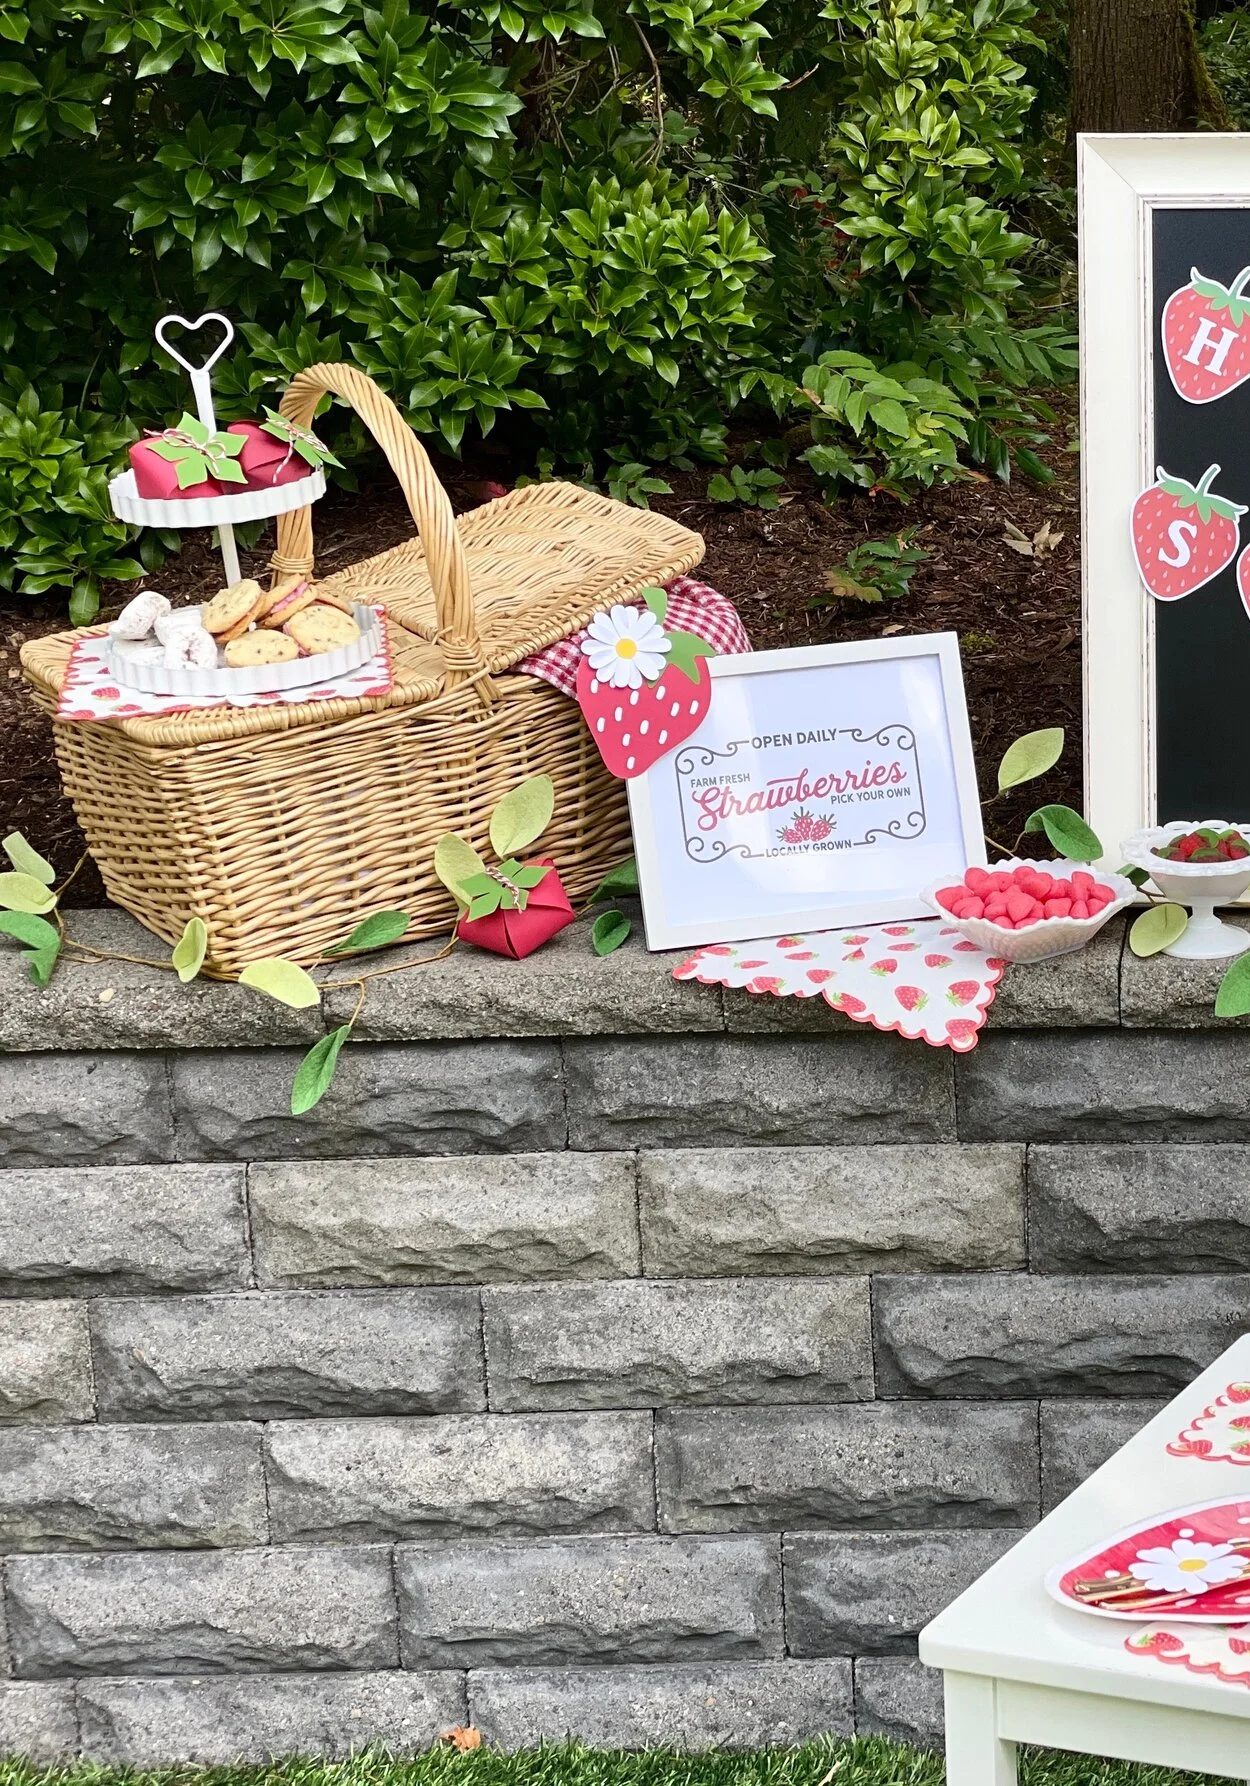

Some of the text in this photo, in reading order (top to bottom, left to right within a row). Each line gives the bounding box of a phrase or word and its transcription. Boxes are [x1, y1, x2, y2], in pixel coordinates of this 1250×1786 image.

[751, 728, 837, 749] OPEN DAILY
[690, 772, 751, 788] FARM FRESH
[691, 760, 907, 832] Strawberries
[830, 786, 911, 805] PICK YOUR OWN
[765, 839, 852, 858] LOCALLY GROWN
